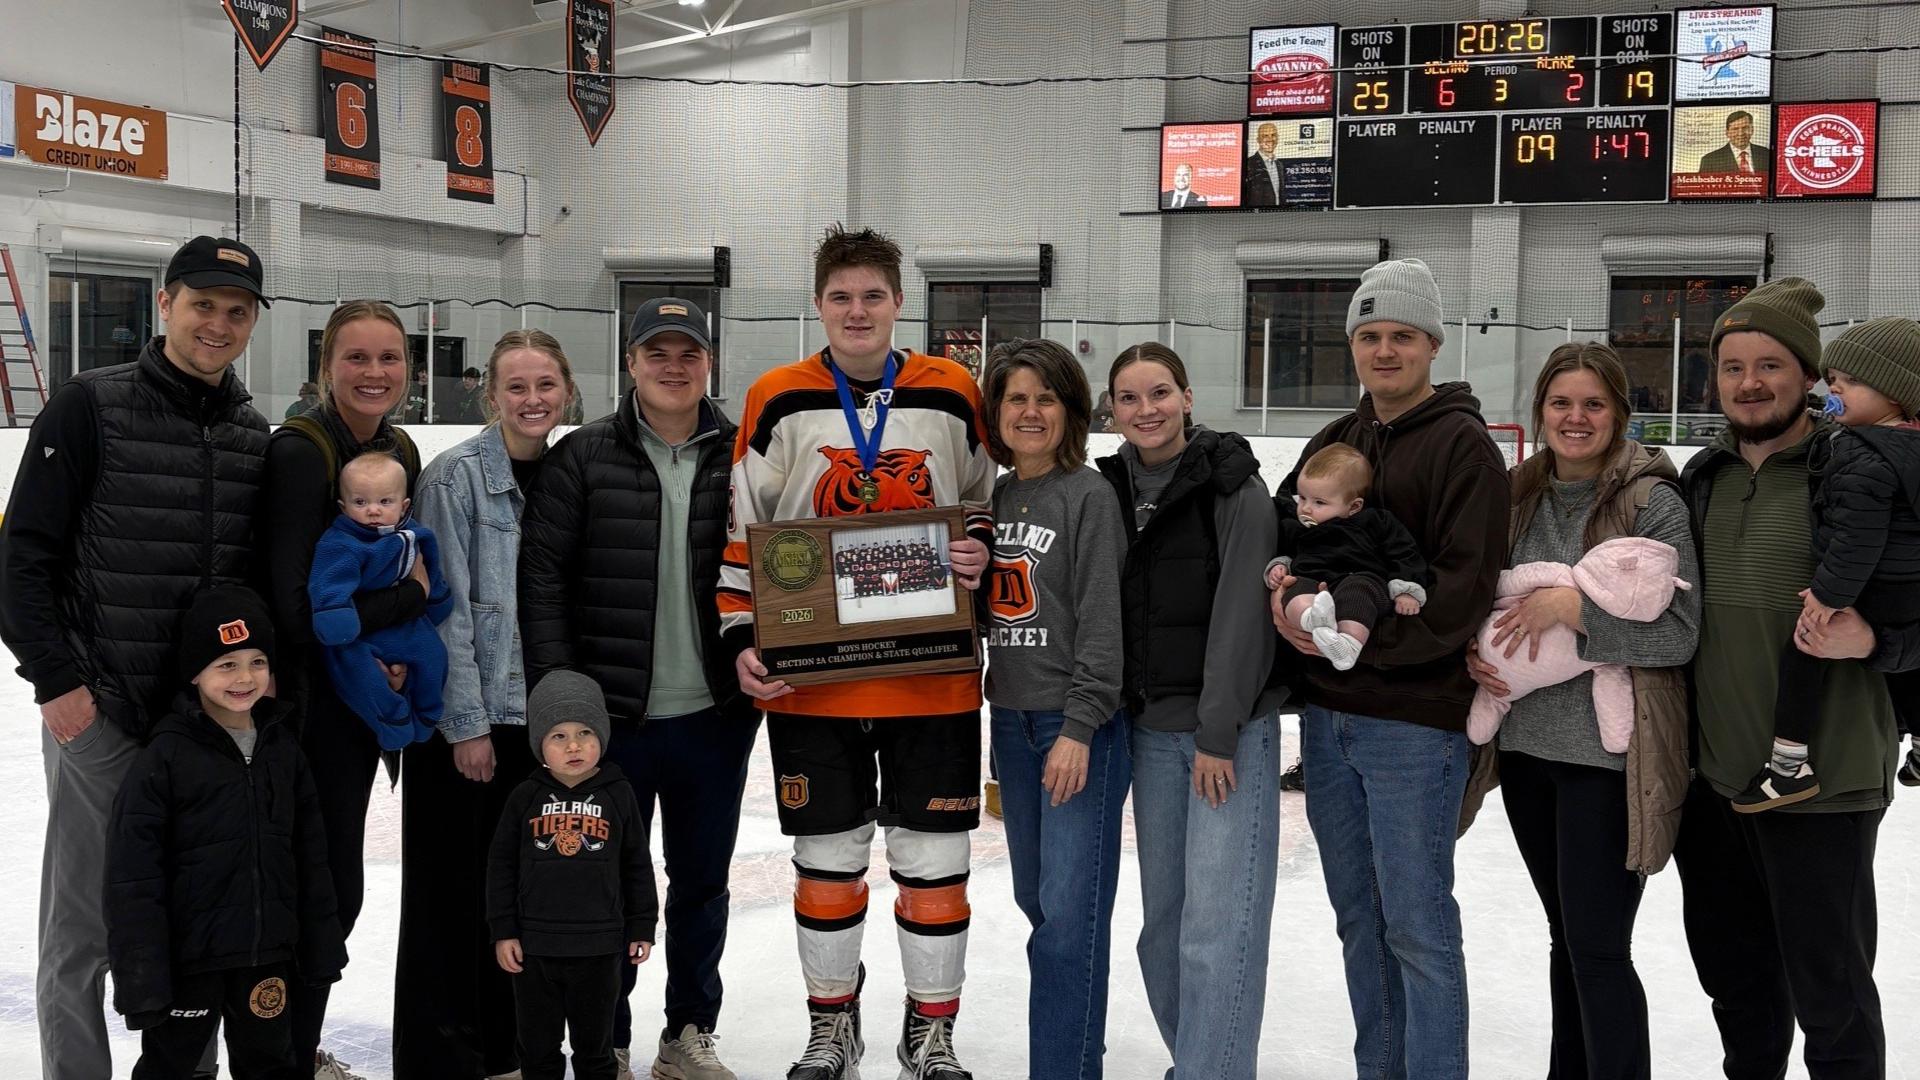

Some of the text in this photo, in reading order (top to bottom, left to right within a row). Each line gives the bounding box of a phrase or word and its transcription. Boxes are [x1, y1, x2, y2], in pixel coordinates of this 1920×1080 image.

[1689, 9, 1762, 19] LIVE STREAMING
[252, 16, 270, 31] 1948
[1612, 18, 1658, 34] SHOTS
[1258, 35, 1326, 50] Feed the Team!
[1351, 31, 1394, 46] SHOTS
[1460, 22, 1544, 54] 20:26
[1625, 35, 1645, 49] ON
[1362, 47, 1381, 61] ON
[1484, 65, 1518, 76] PERIOD
[1266, 87, 1314, 97] Order ahead at
[1439, 79, 1456, 106] 6
[1495, 79, 1508, 102] 3
[1565, 73, 1585, 102] 2
[1627, 71, 1654, 99] 19
[1256, 95, 1325, 107] DAVANNIS.COM
[1354, 82, 1390, 110] 25
[336, 82, 367, 149] 6
[1511, 115, 1647, 132] PLAYER PENALTY
[36, 93, 146, 156] Blaze
[1348, 120, 1476, 138] PLAYER PENALTY
[1799, 123, 1852, 141] EDEN PRAIRIE
[456, 105, 484, 168] 8
[1517, 131, 1650, 163] 09 1:47
[1784, 145, 1865, 158] SCHEELS
[46, 148, 136, 175] CREDIT UNION
[1725, 175, 1733, 183] &
[1734, 174, 1762, 185] Spence
[1800, 166, 1848, 180] MINNESOTA
[988, 522, 1057, 554] ELANO
[784, 611, 811, 622] 2026
[837, 640, 897, 654] BOYS HOCKEY
[776, 644, 959, 669] SECTION 2A CHAMPION & STATE QUALIFIER
[541, 801, 603, 818] DELANO
[529, 813, 610, 841] TIGERS
[169, 1008, 209, 1018] CCM
